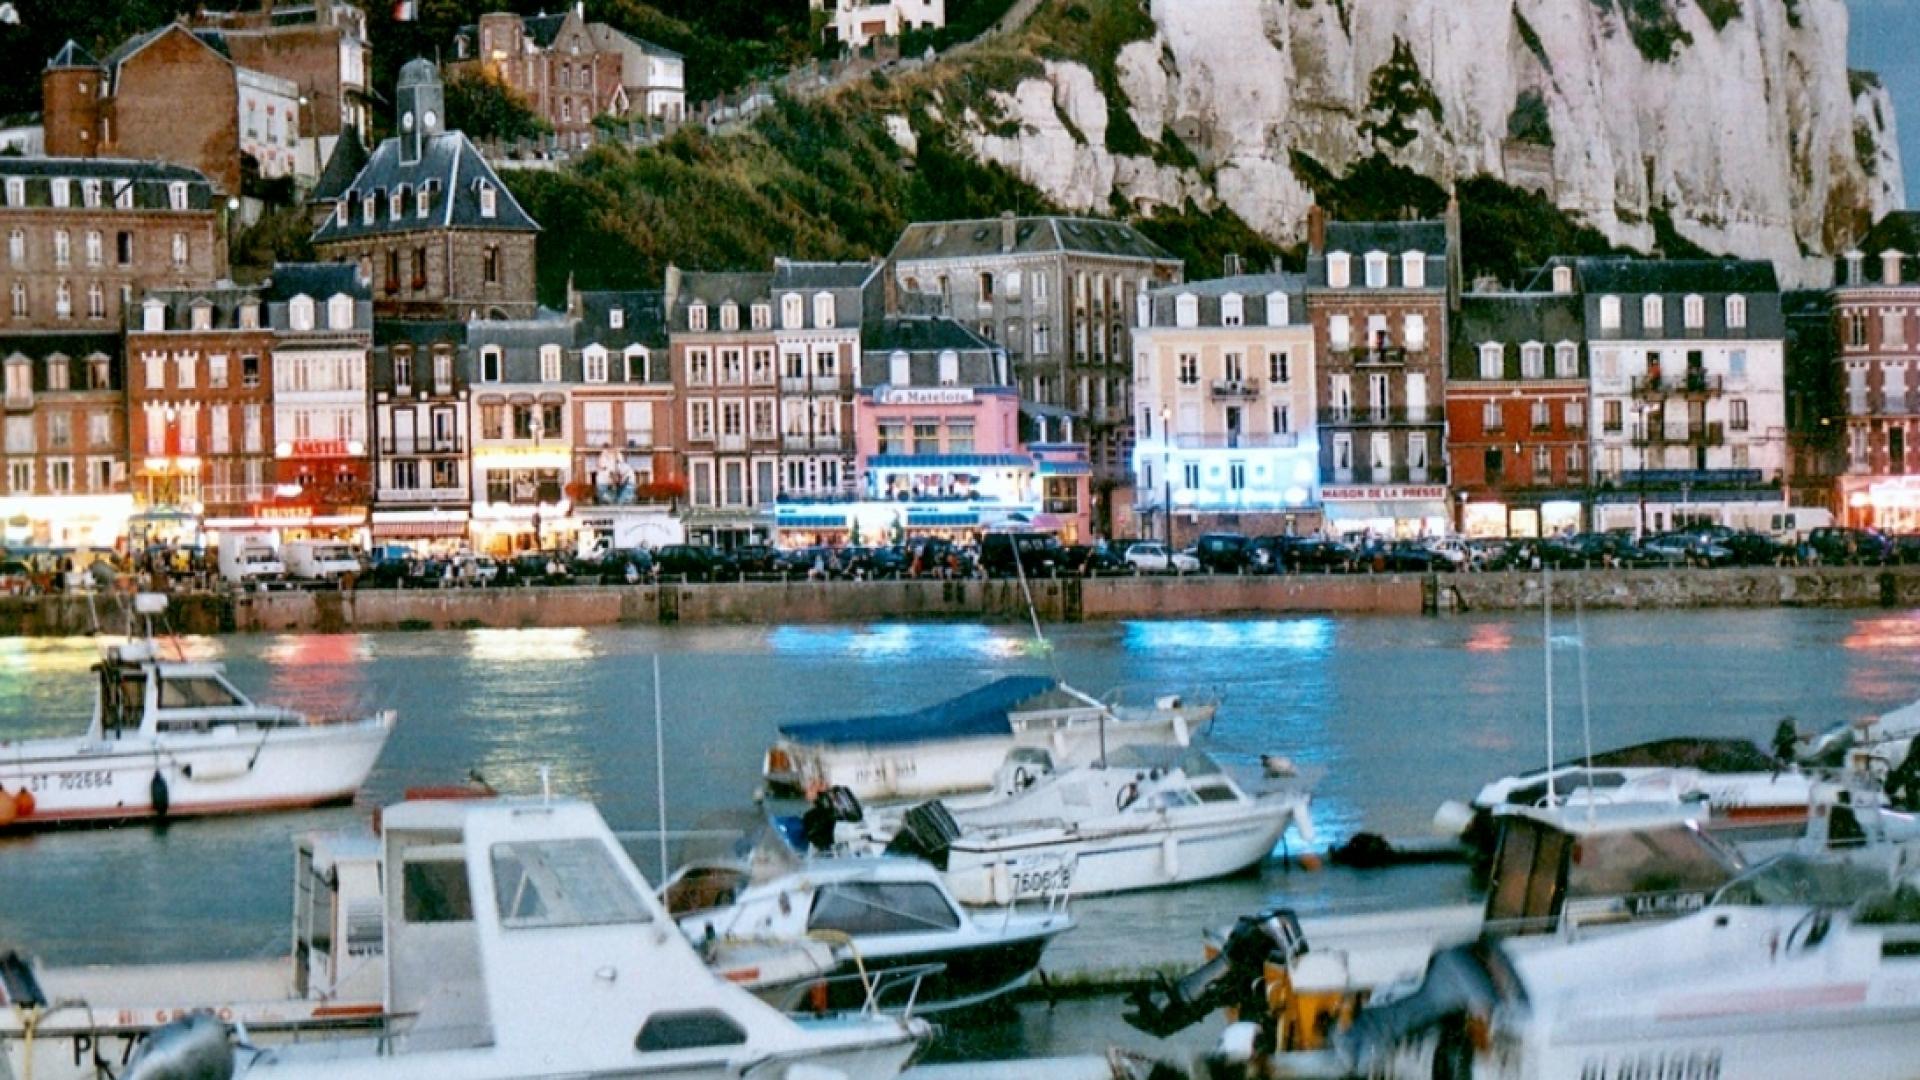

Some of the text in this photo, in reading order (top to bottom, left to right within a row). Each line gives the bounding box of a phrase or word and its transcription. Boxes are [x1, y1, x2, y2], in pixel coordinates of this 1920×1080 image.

[1322, 487, 1443, 498] MAISON DE LA PRESSE
